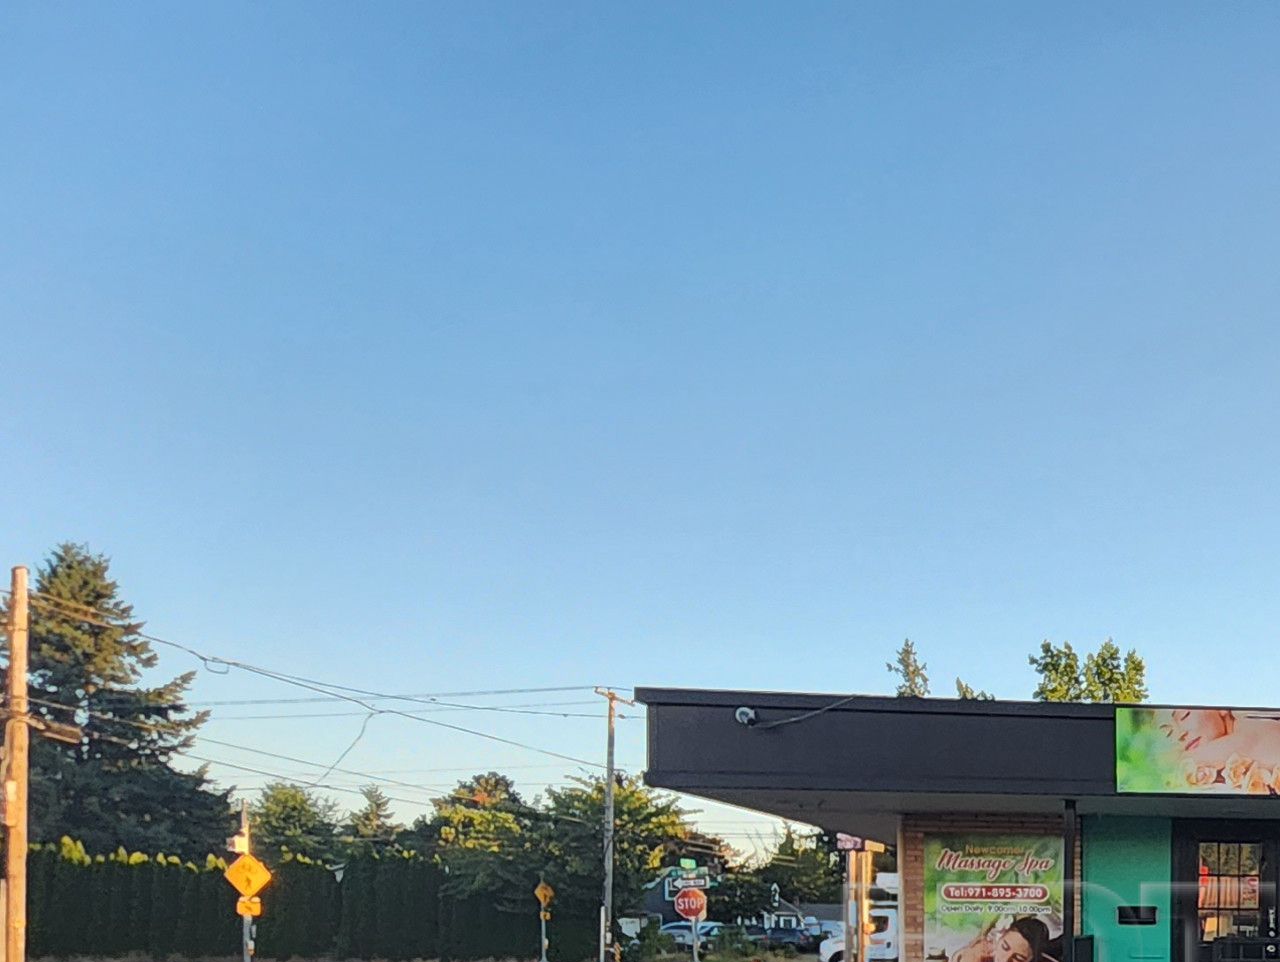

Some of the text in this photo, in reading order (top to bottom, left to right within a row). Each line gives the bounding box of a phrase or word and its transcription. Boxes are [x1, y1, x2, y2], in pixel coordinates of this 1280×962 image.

[937, 849, 1053, 881] Massage Spa
[677, 897, 704, 909] STOP
